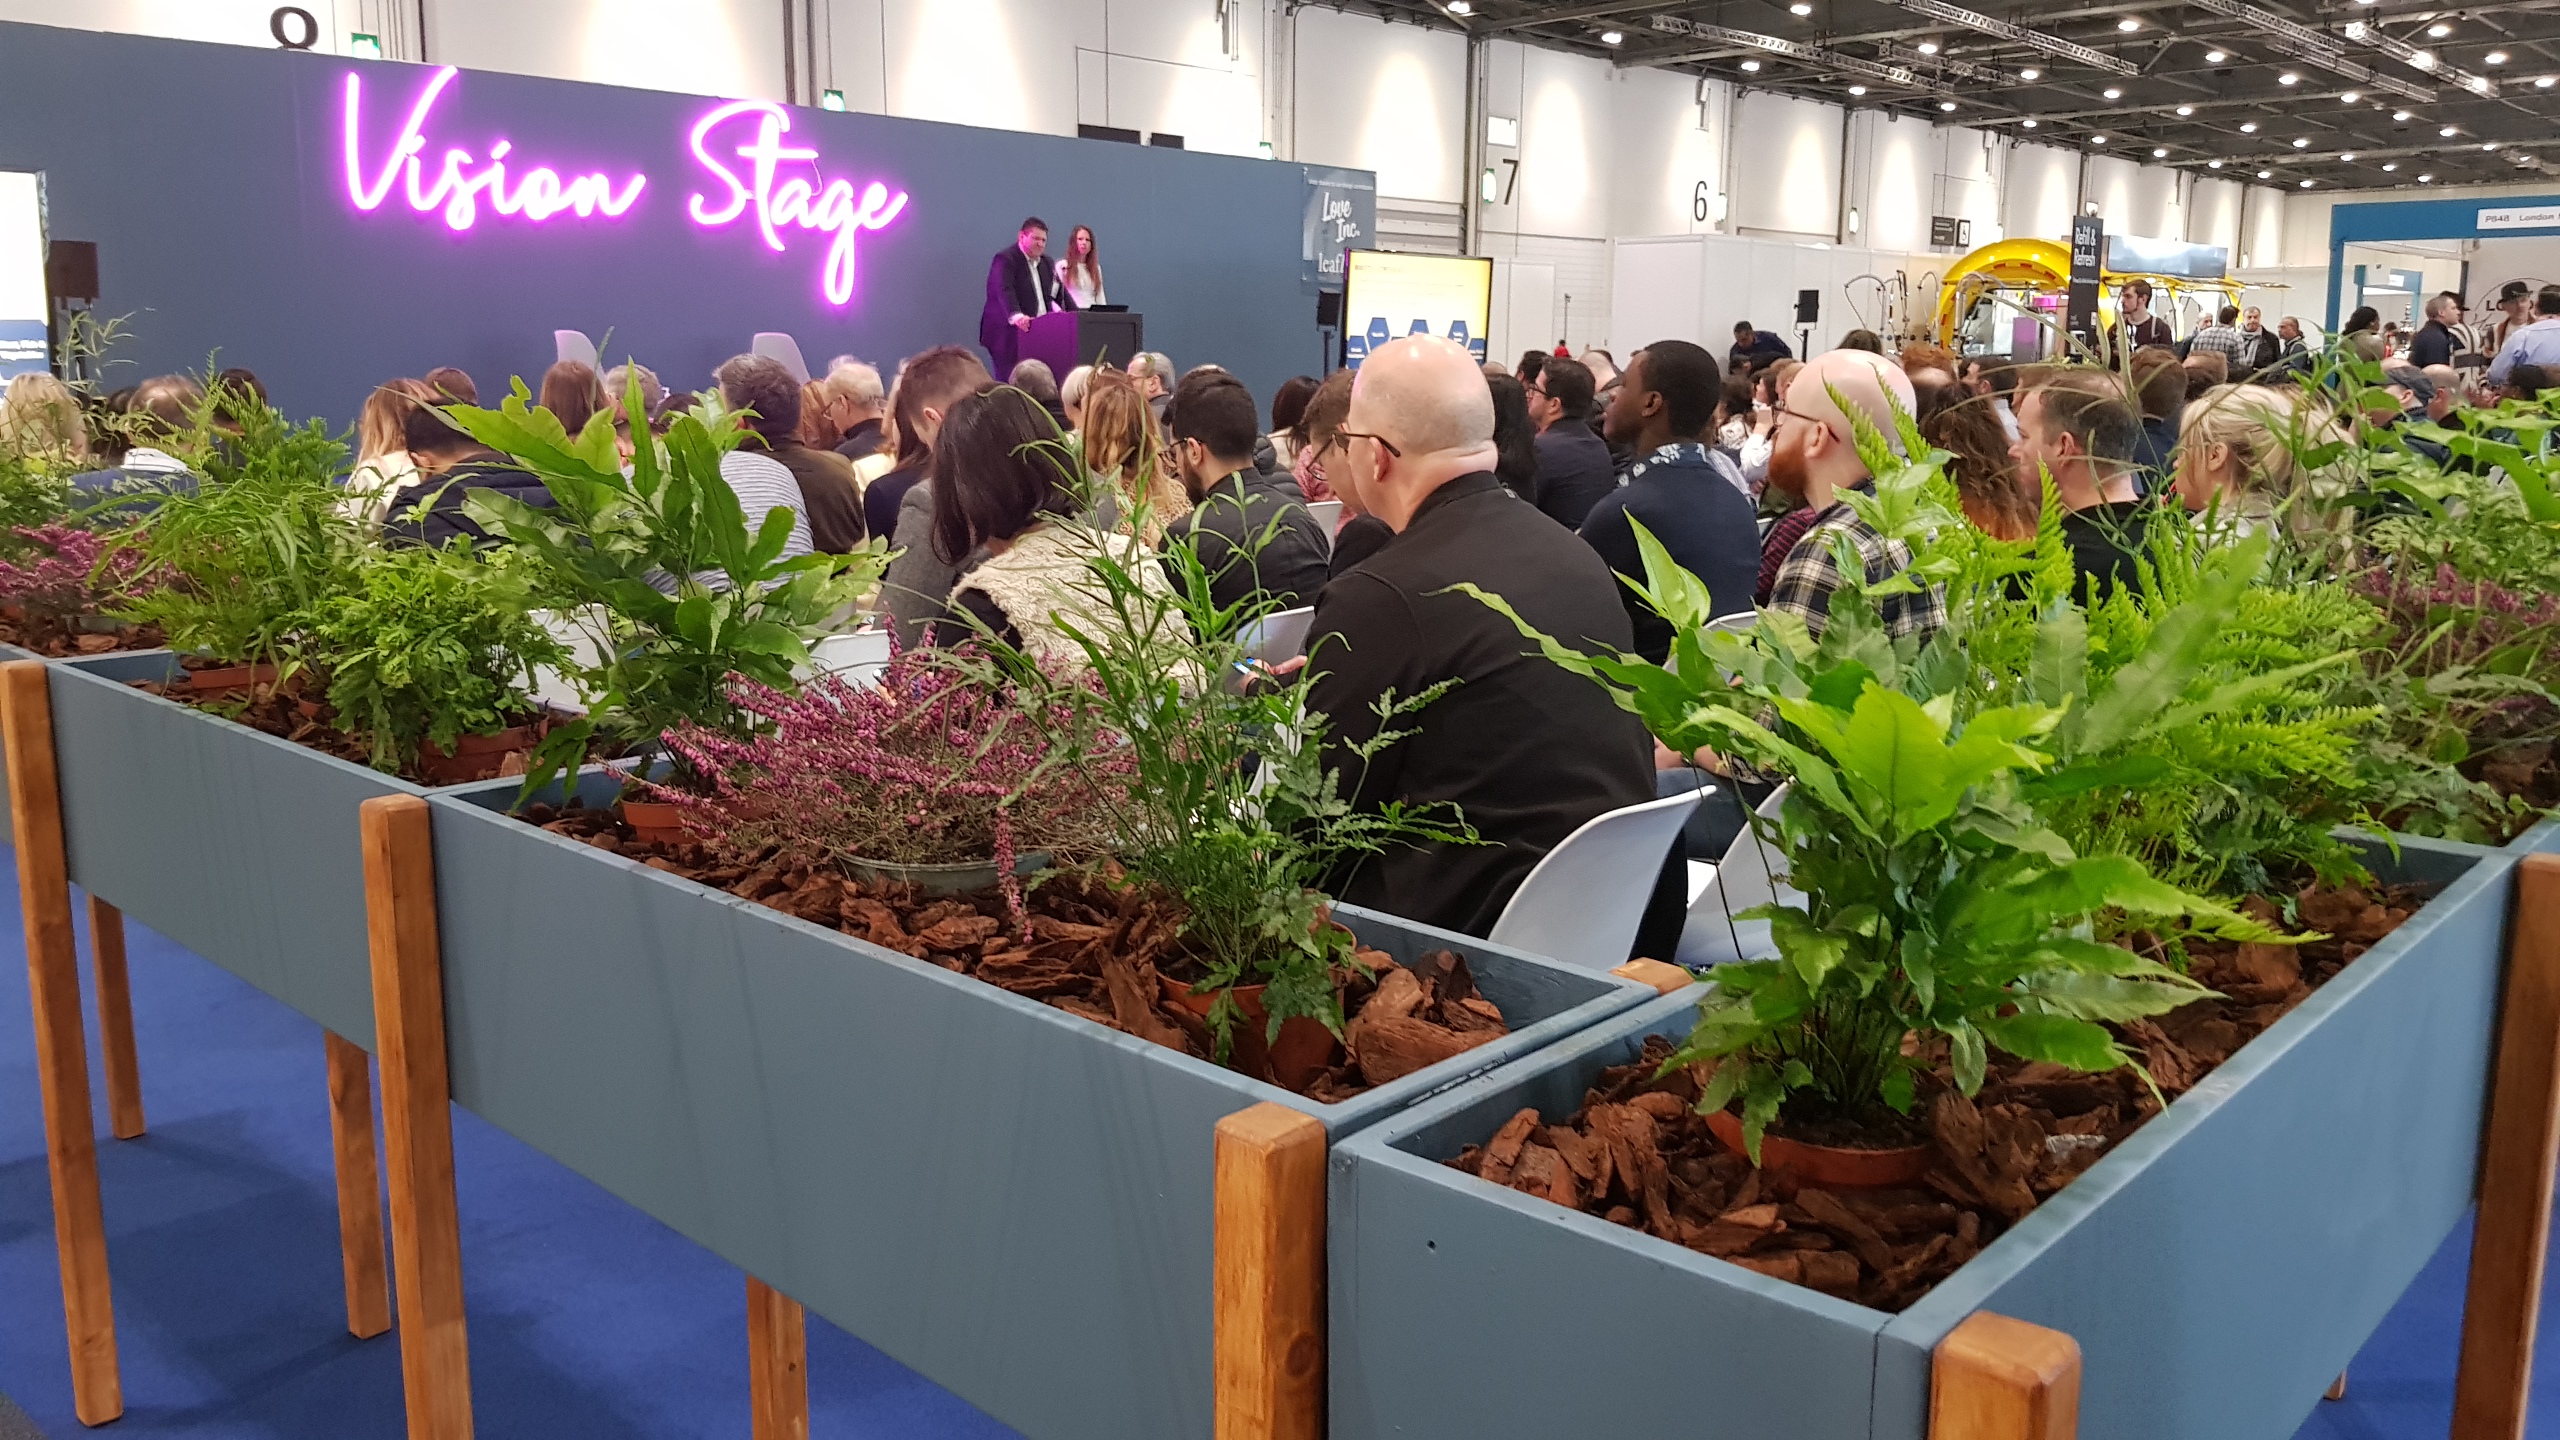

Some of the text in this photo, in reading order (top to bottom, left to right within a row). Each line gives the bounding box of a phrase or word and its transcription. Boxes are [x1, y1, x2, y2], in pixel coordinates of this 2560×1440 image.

[344, 64, 910, 306] Vision Stage
[1502, 158, 1519, 206] 7
[1321, 191, 1353, 222] Love
[1694, 180, 1707, 222] 6
[1335, 218, 1361, 243] Inc.
[2519, 213, 2555, 222] London
[2074, 225, 2096, 246] Refill &
[2073, 246, 2096, 267] Refresh
